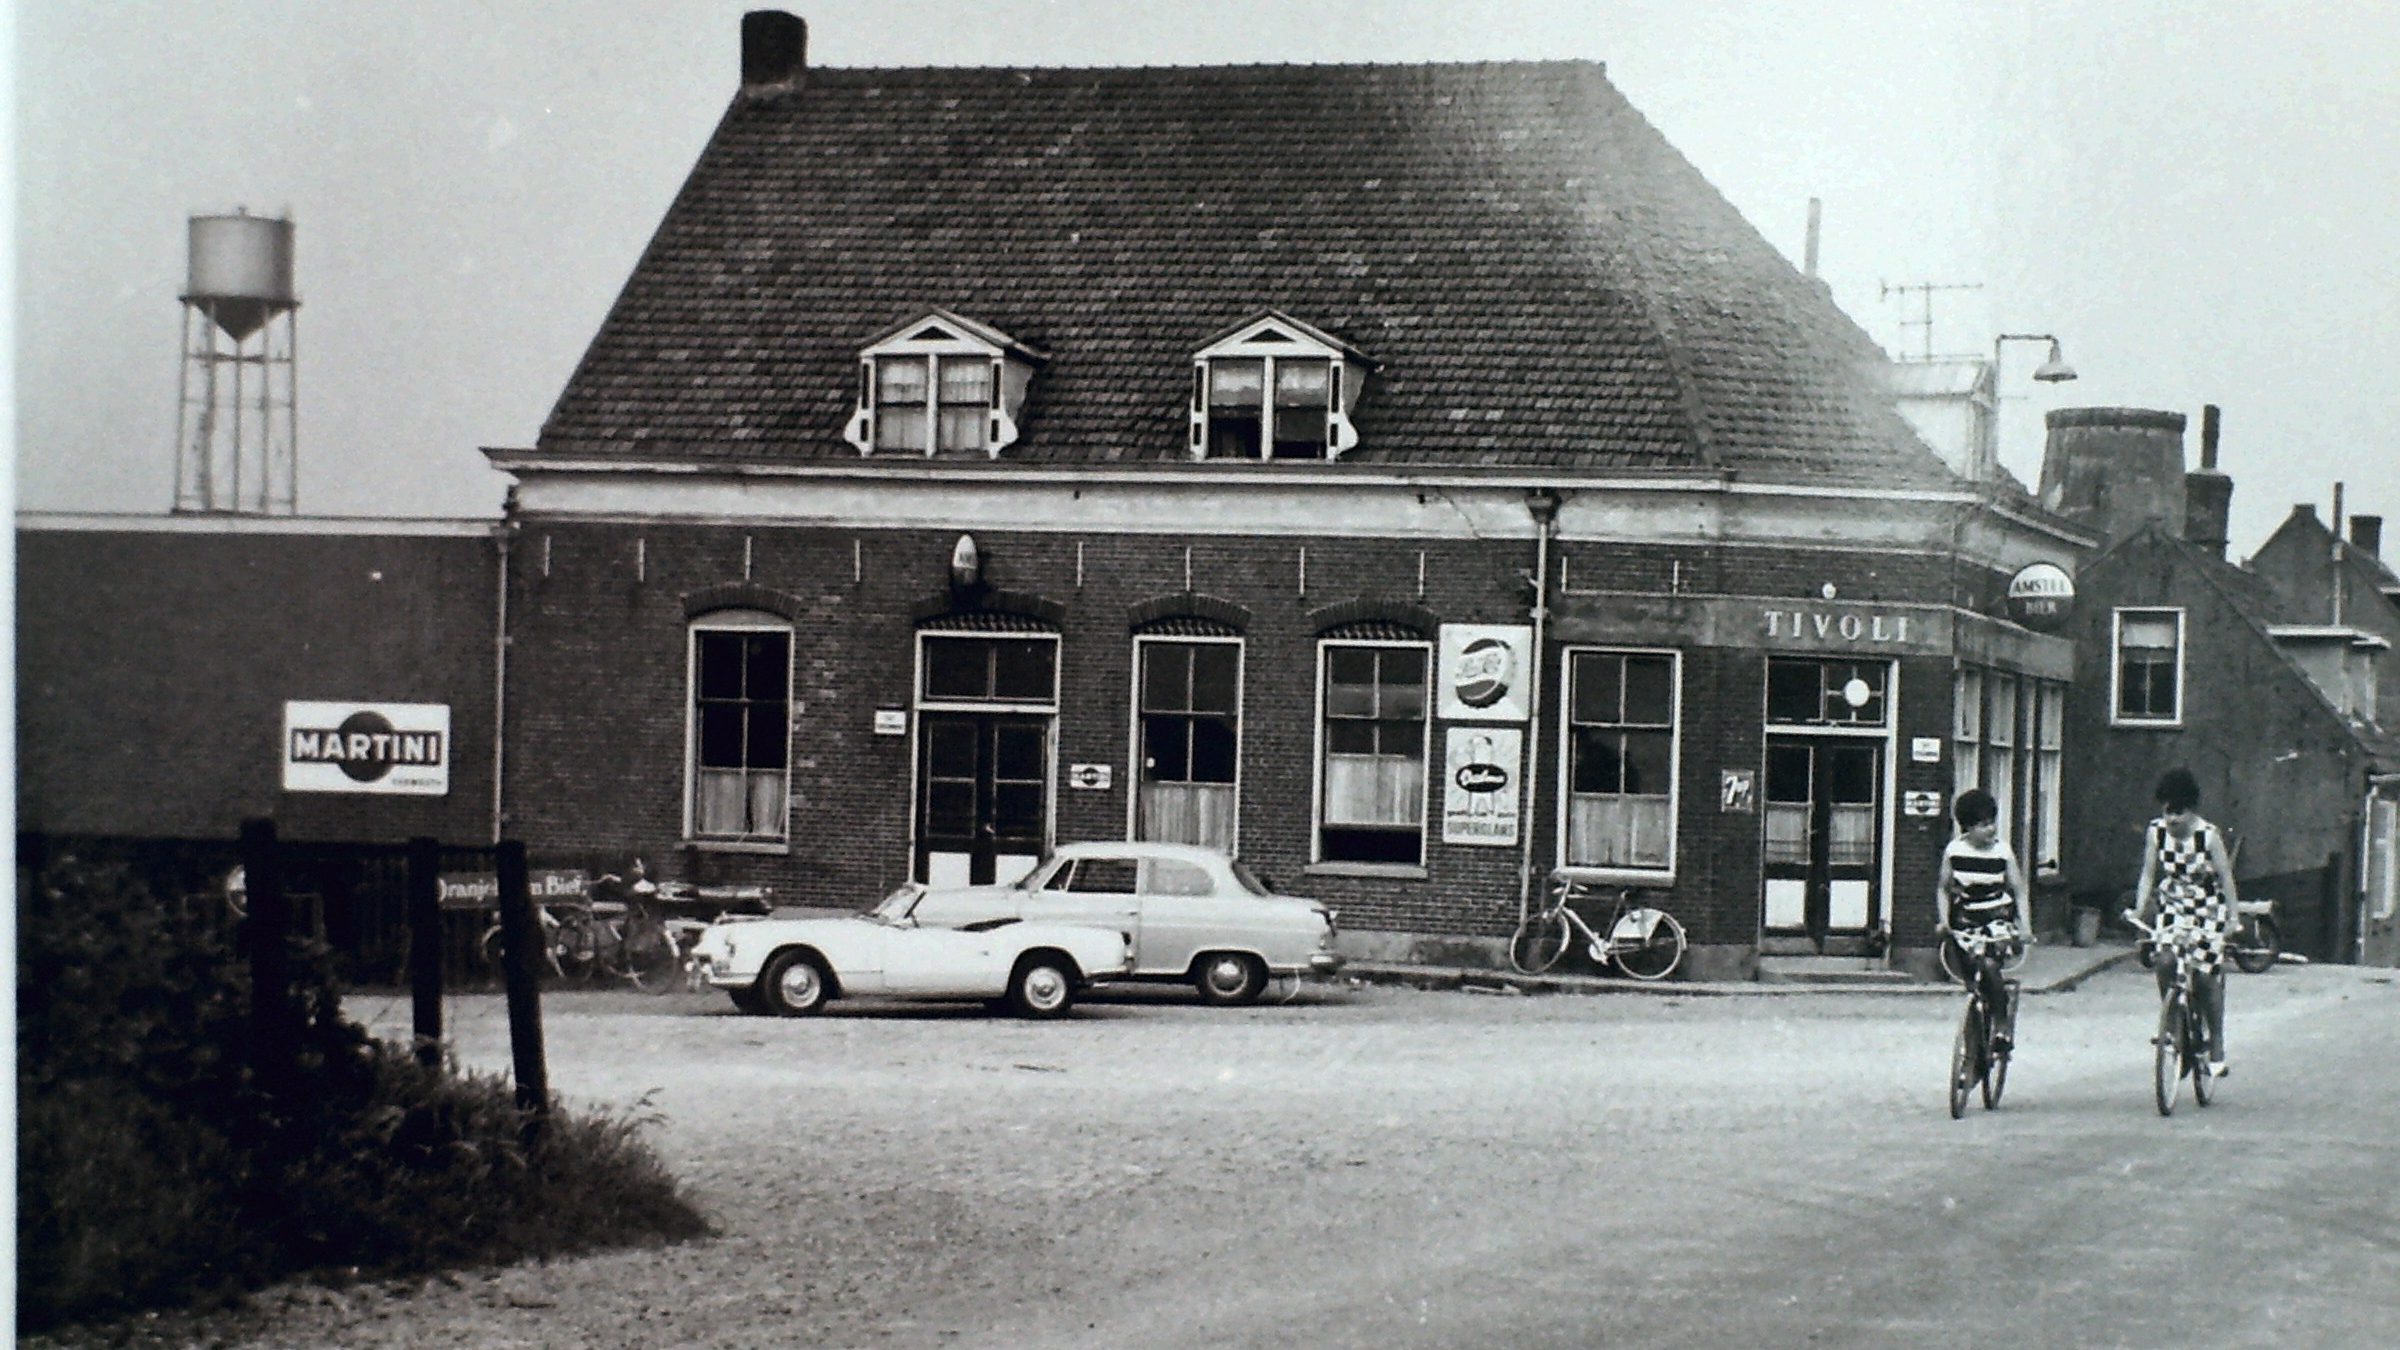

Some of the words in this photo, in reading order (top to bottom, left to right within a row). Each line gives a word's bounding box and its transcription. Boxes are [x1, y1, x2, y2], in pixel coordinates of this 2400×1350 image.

[2013, 578, 2067, 594] AMSTEL
[2025, 600, 2057, 615] BIER
[1763, 610, 1909, 642] TIVOLI
[293, 731, 438, 762] MARTINI
